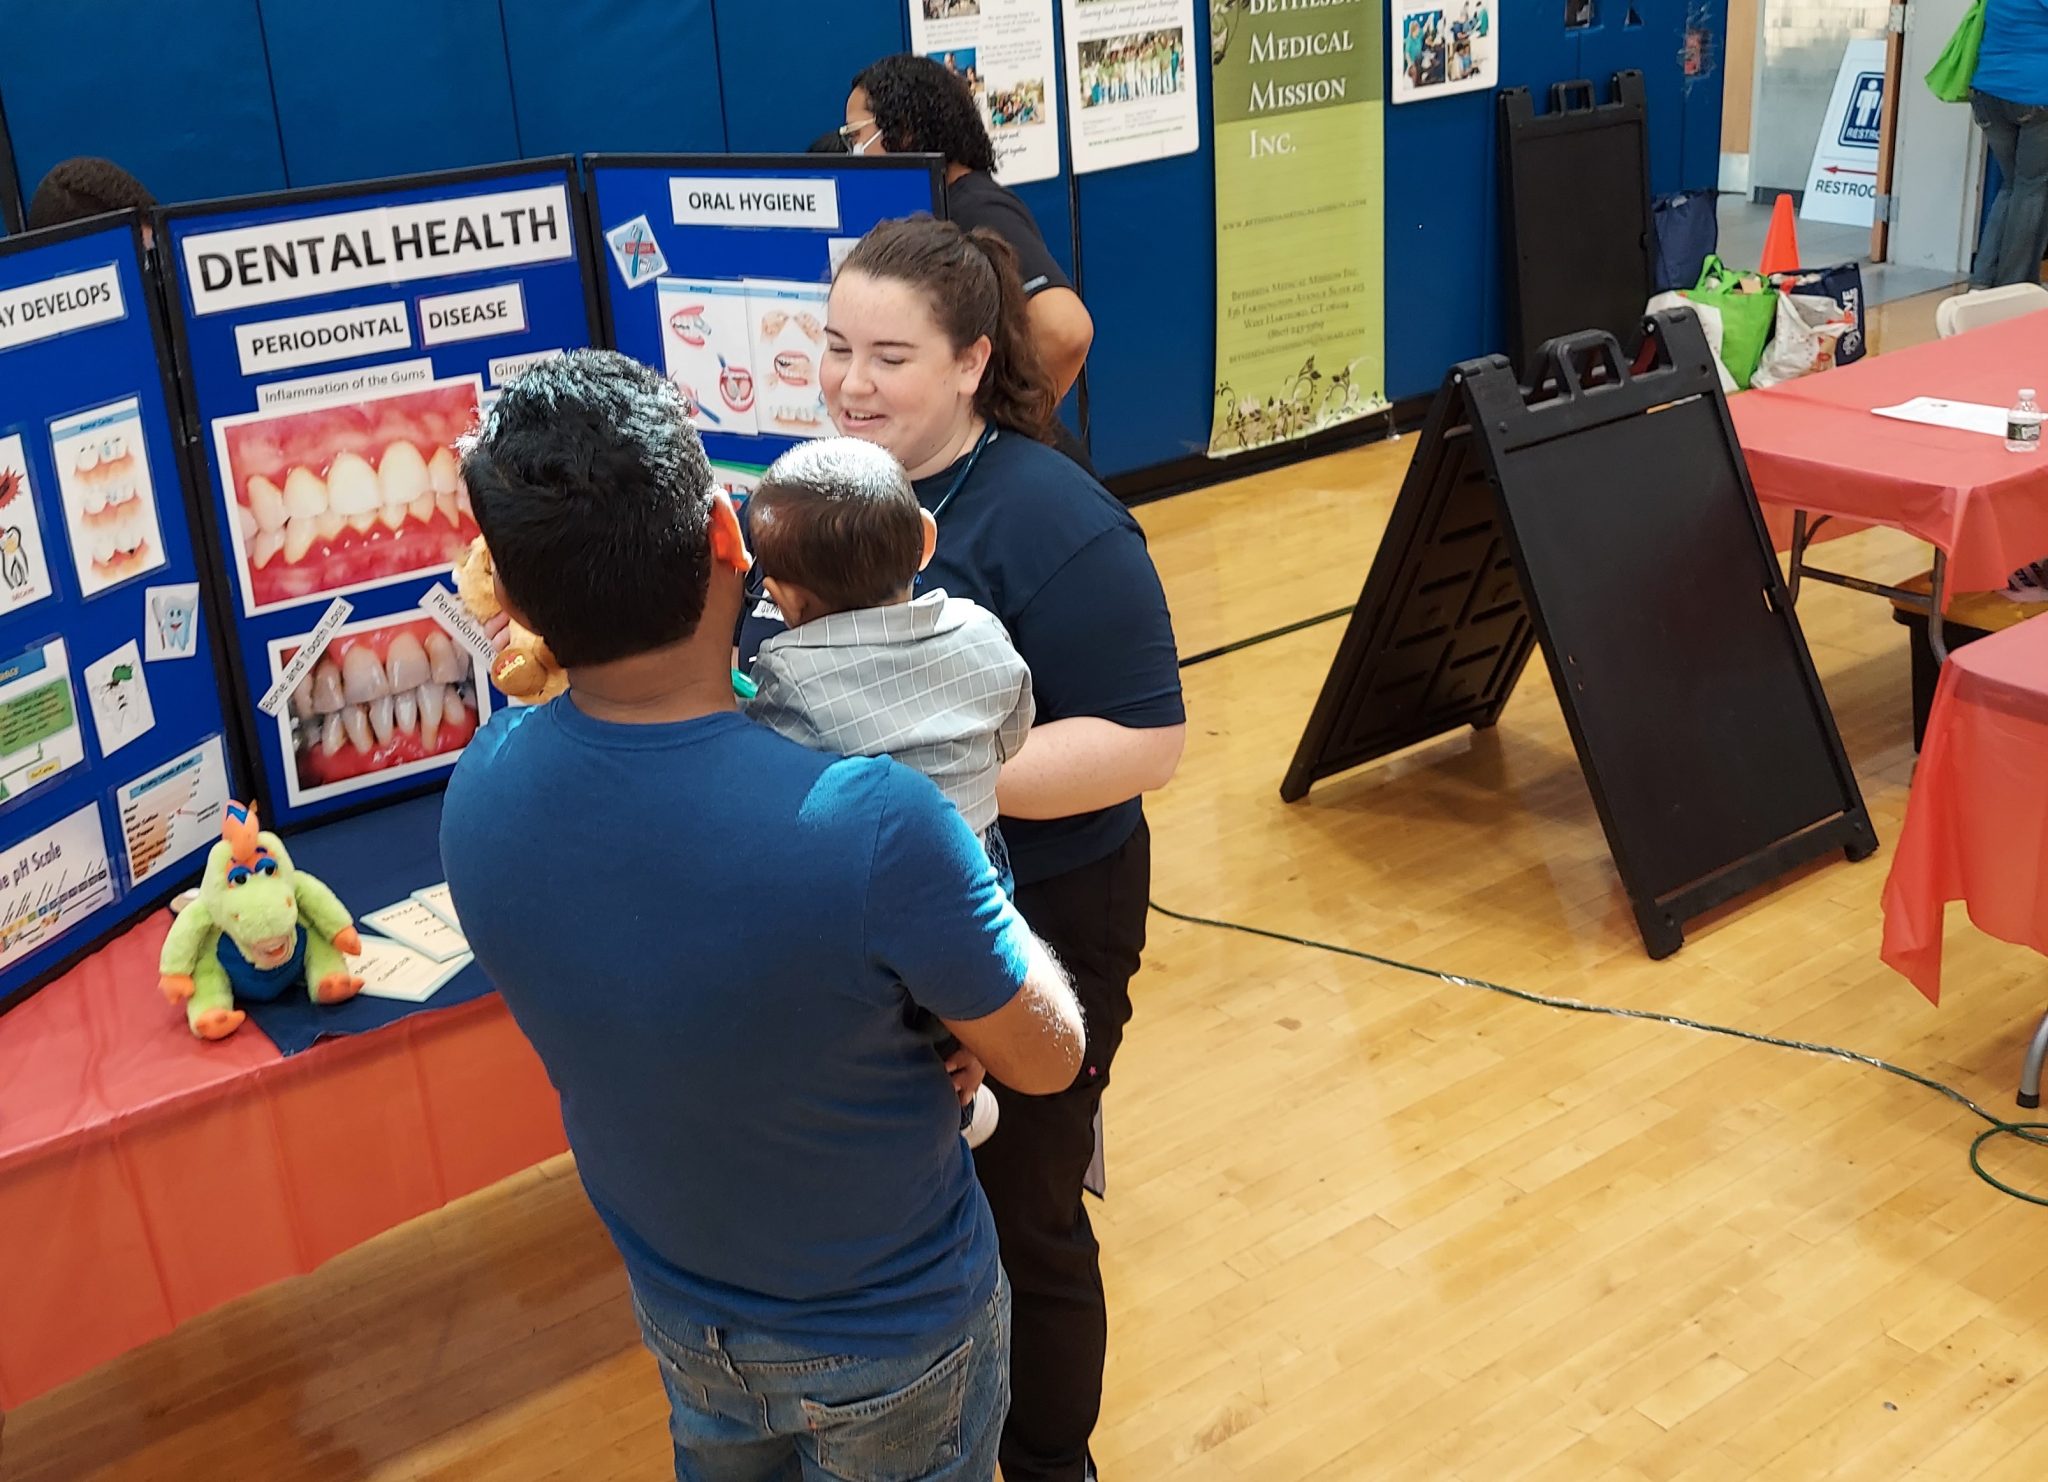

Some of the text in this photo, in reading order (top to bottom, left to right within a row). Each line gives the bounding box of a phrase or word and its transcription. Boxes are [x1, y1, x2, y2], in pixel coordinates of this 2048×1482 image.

[1249, 30, 1354, 64] MEDICAL
[1249, 77, 1347, 112] MISSION
[1846, 127, 1881, 140] RESTRO
[688, 192, 817, 212] ORAL HYGIENE
[1815, 179, 1877, 198] RESTROO
[198, 205, 558, 292] DENTAL HEALTH
[21, 282, 111, 322] DEVELOPS
[428, 300, 508, 330] DISEASE
[252, 316, 404, 357] PERIODONTAL
[264, 368, 427, 404] Inflammation of the Gums
[432, 593, 496, 661] Periodontitis
[262, 604, 347, 711] Bone and Tooth Loss
[13, 857, 30, 887] pH
[34, 841, 63, 872] Scale
